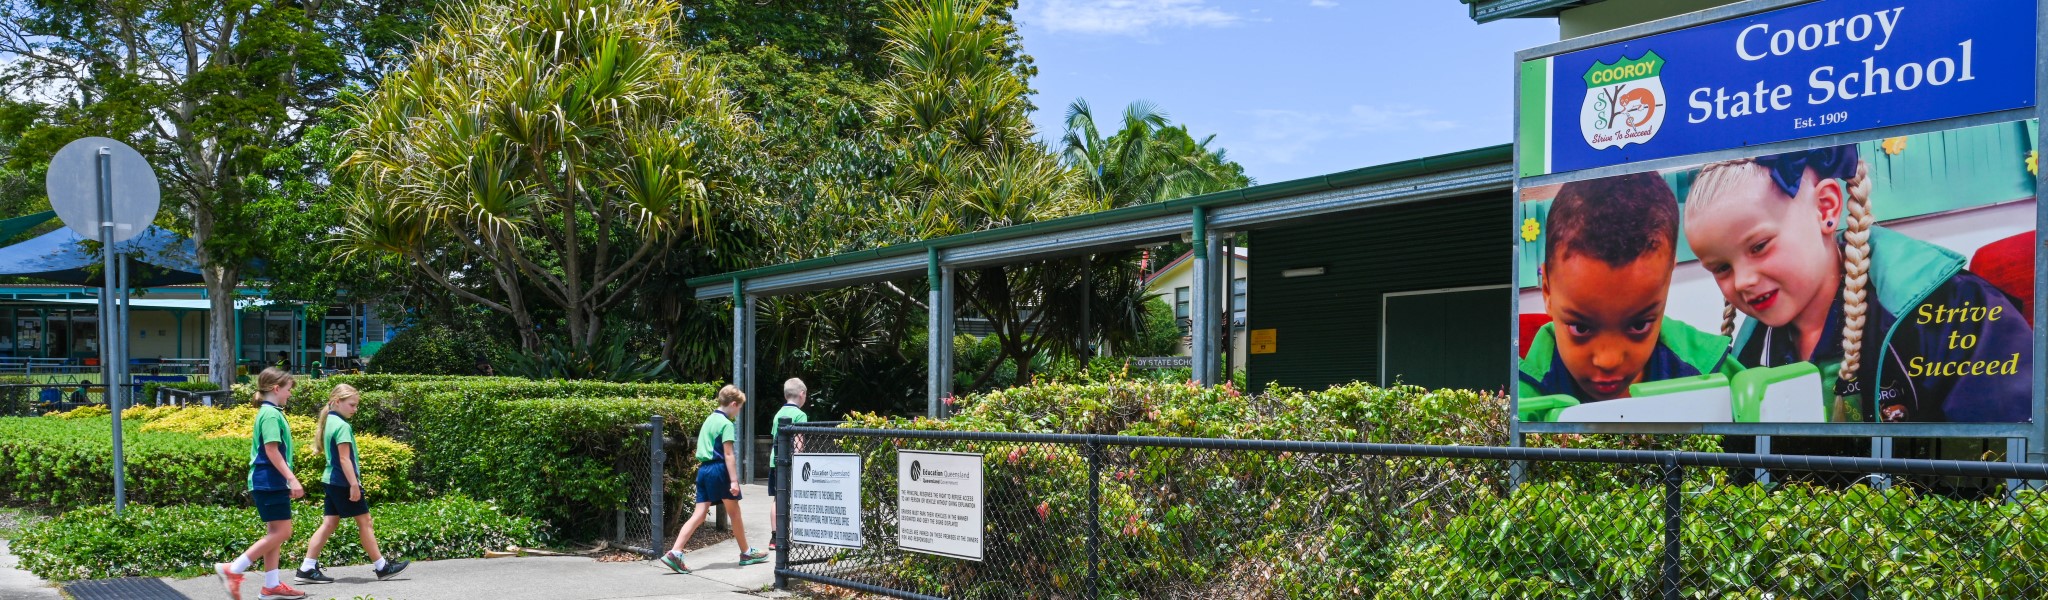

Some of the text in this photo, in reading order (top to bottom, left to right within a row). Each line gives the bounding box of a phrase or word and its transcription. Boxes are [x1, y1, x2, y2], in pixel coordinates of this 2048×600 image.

[1736, 6, 1905, 61] Cooroy
[1592, 60, 1656, 84] COOROY
[1688, 38, 1976, 124] State School
[1794, 111, 1848, 129] Est. 1909
[1592, 125, 1653, 143] Strive To Succeed
[1916, 301, 2003, 324] Strive
[1948, 330, 1976, 349] to
[1908, 352, 2020, 377] Succeed
